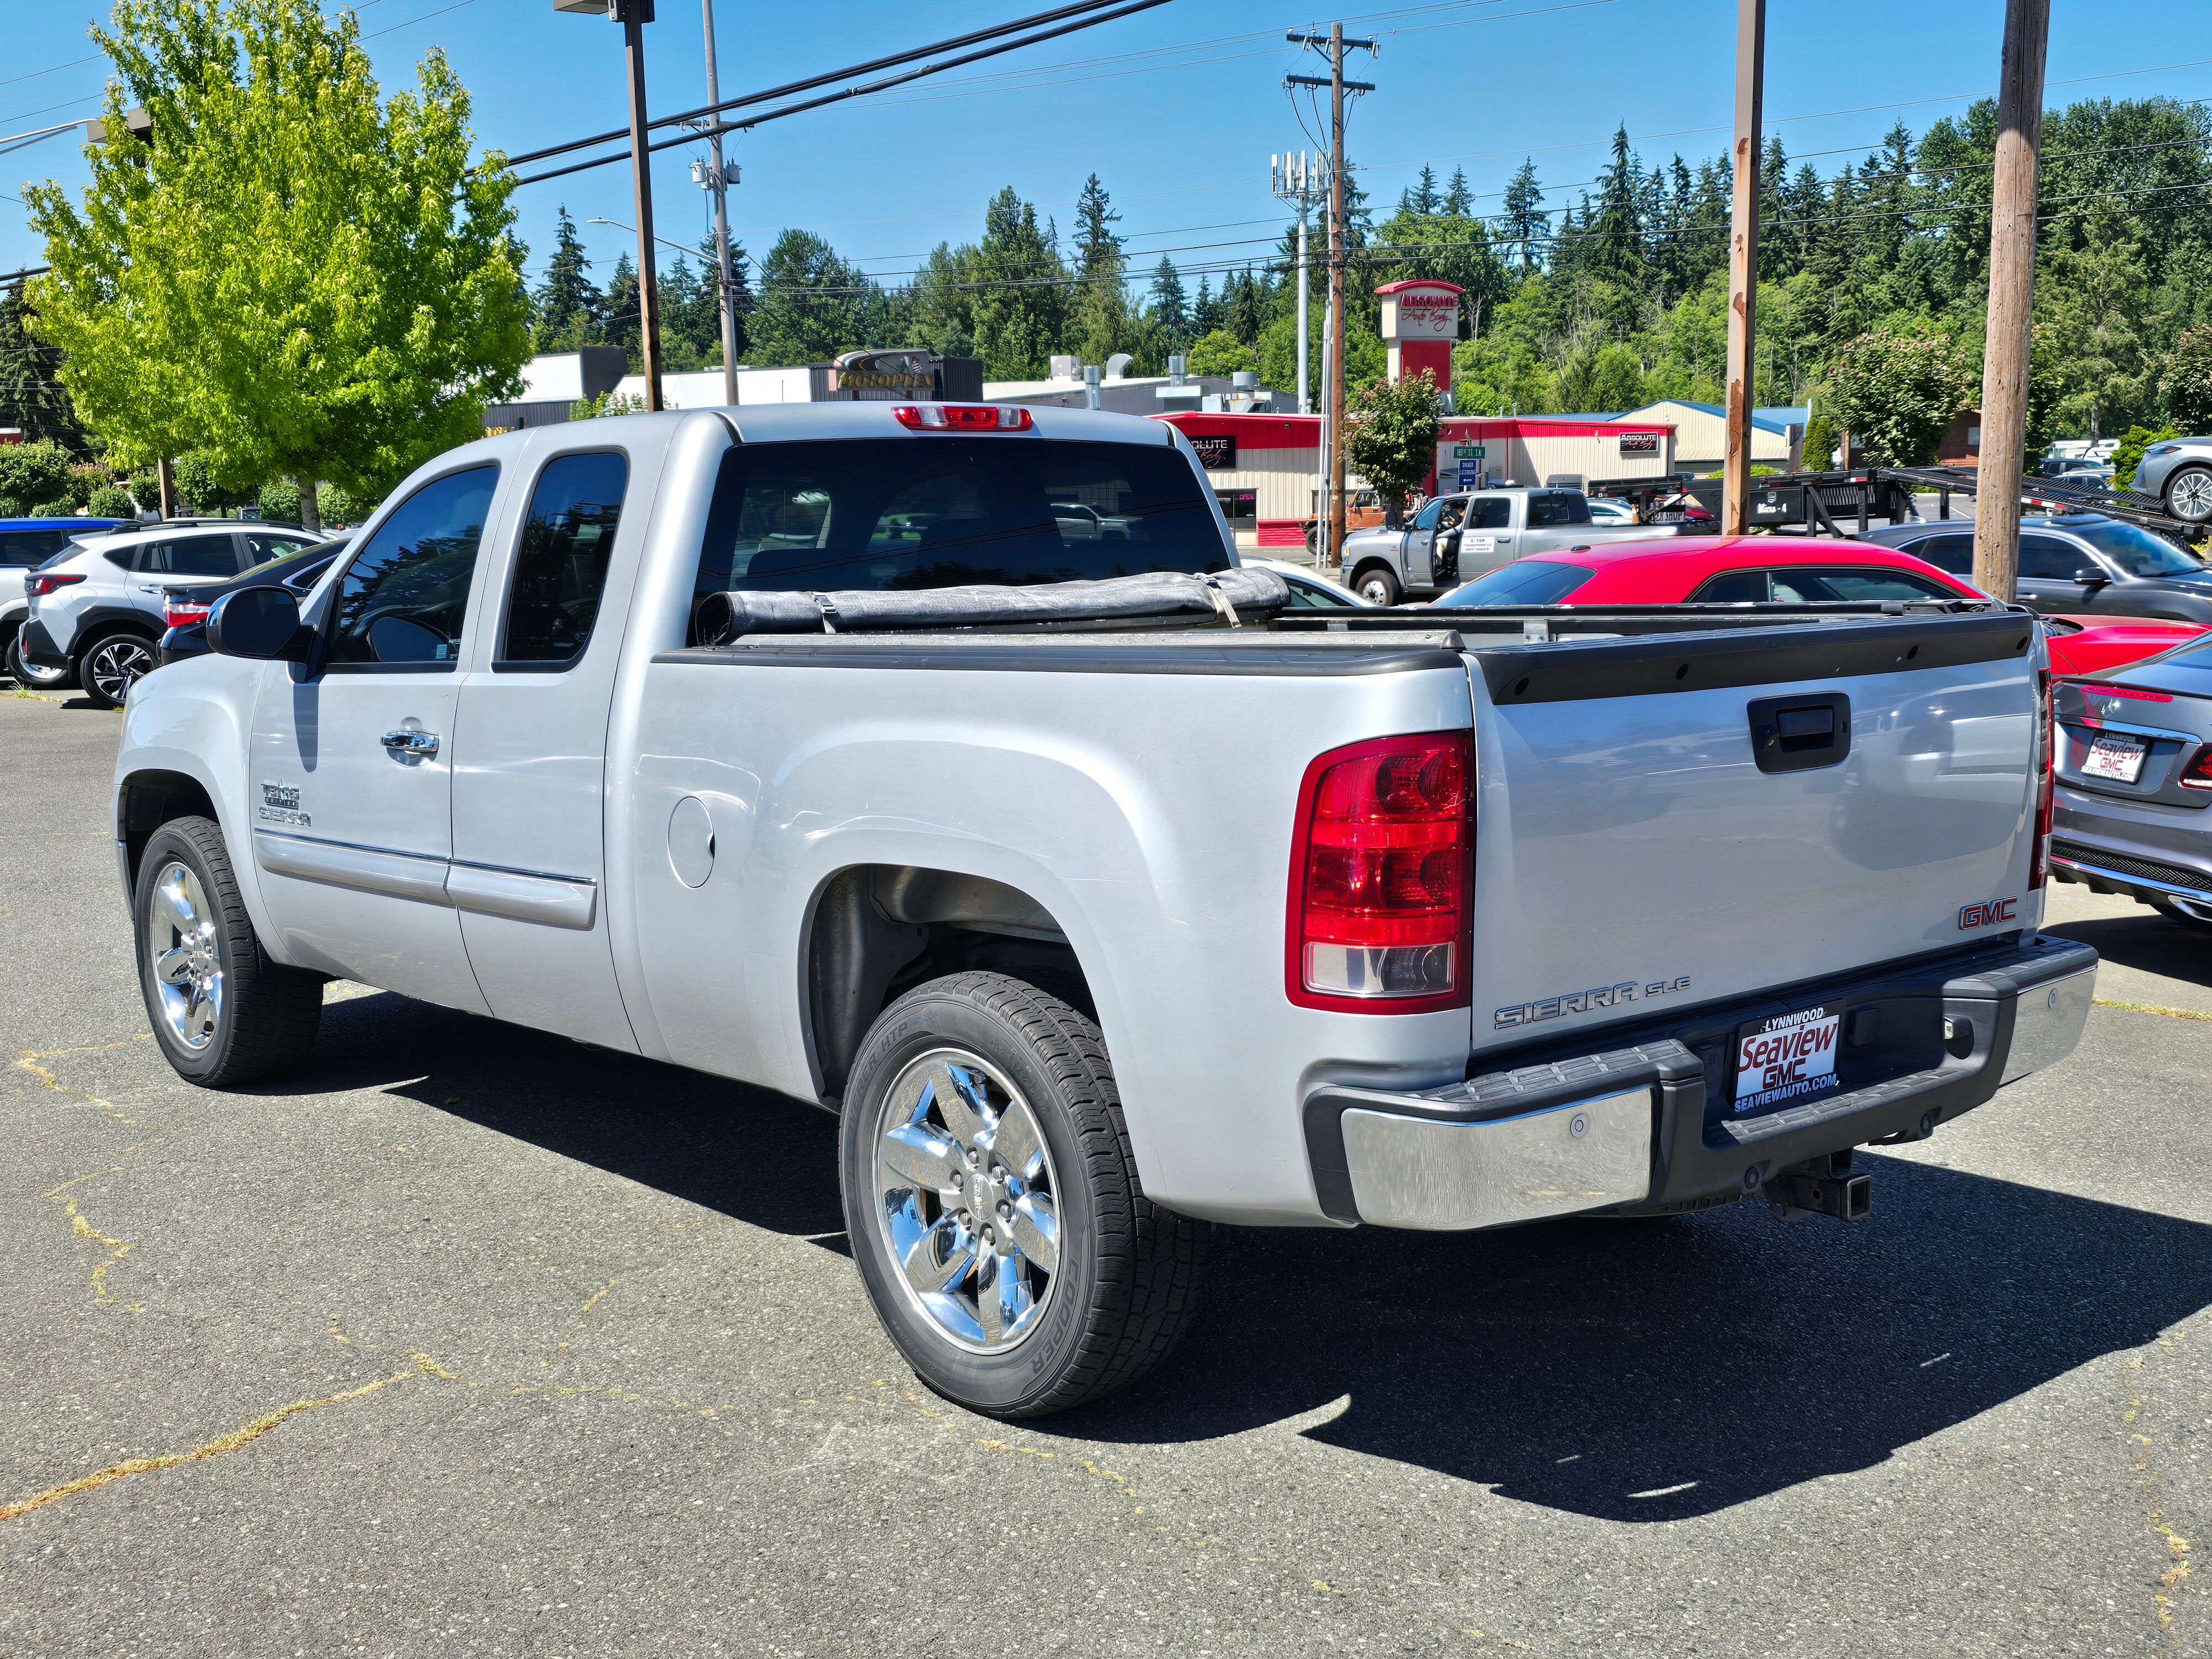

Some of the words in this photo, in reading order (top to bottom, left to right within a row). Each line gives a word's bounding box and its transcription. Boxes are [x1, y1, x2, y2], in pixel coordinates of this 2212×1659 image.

[1400, 294, 1458, 307] ABSOLUTE
[2090, 738, 2146, 761] Seaview
[2100, 757, 2124, 771] GMC
[259, 805, 312, 827] SIERRA
[1959, 895, 2017, 930] GMC
[1494, 980, 1639, 1030] SIERRA
[1646, 976, 1691, 998] SLE
[1765, 1007, 1824, 1032] LYNNWOOD
[880, 1022, 908, 1052] HTP
[1739, 1023, 1838, 1073] Seaview
[1762, 1057, 1807, 1089] GMC
[1734, 1073, 1837, 1113] SEAVIEWAUTO.COM
[974, 1176, 983, 1219] GMC
[1031, 1256, 1079, 1375] COOPER
